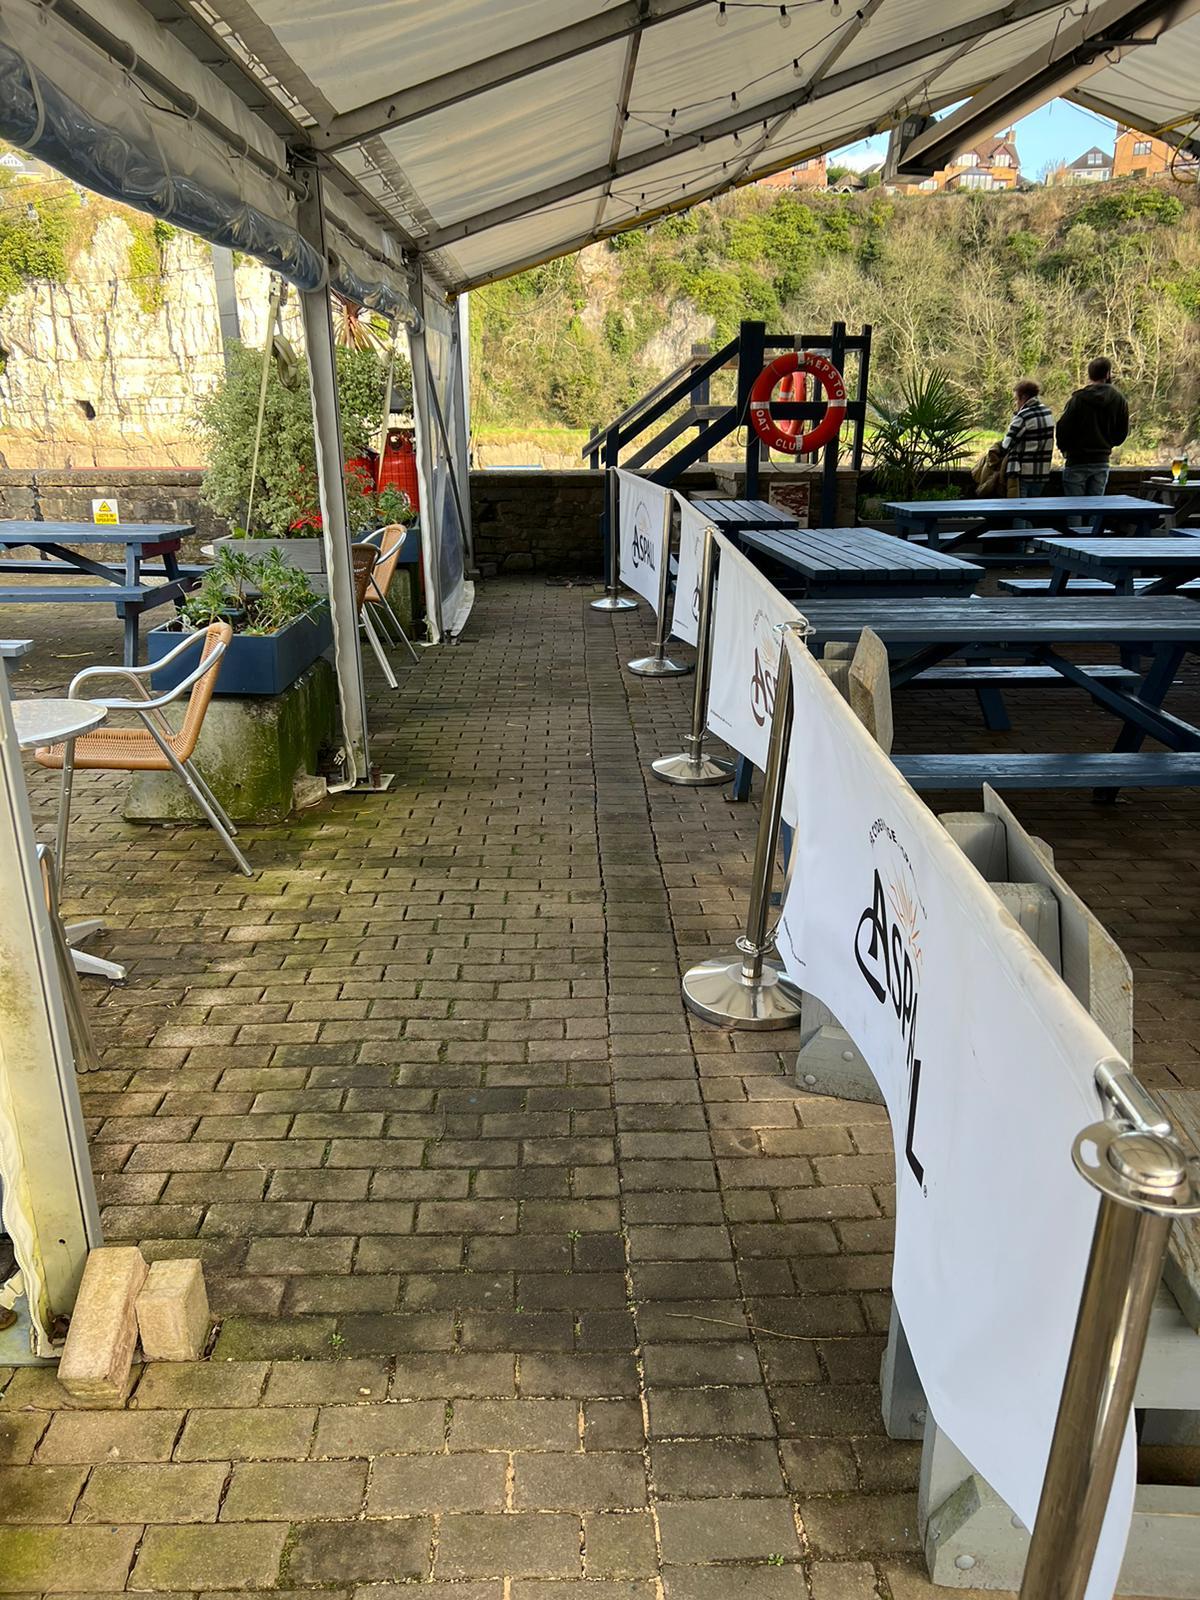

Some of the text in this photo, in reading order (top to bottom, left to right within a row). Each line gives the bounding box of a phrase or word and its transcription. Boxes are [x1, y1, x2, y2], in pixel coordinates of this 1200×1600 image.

[806, 357, 844, 397] HEPSTO
[756, 409, 770, 431] OAT
[632, 525, 655, 572] ASPALL
[854, 868, 924, 1188] ASPAL
